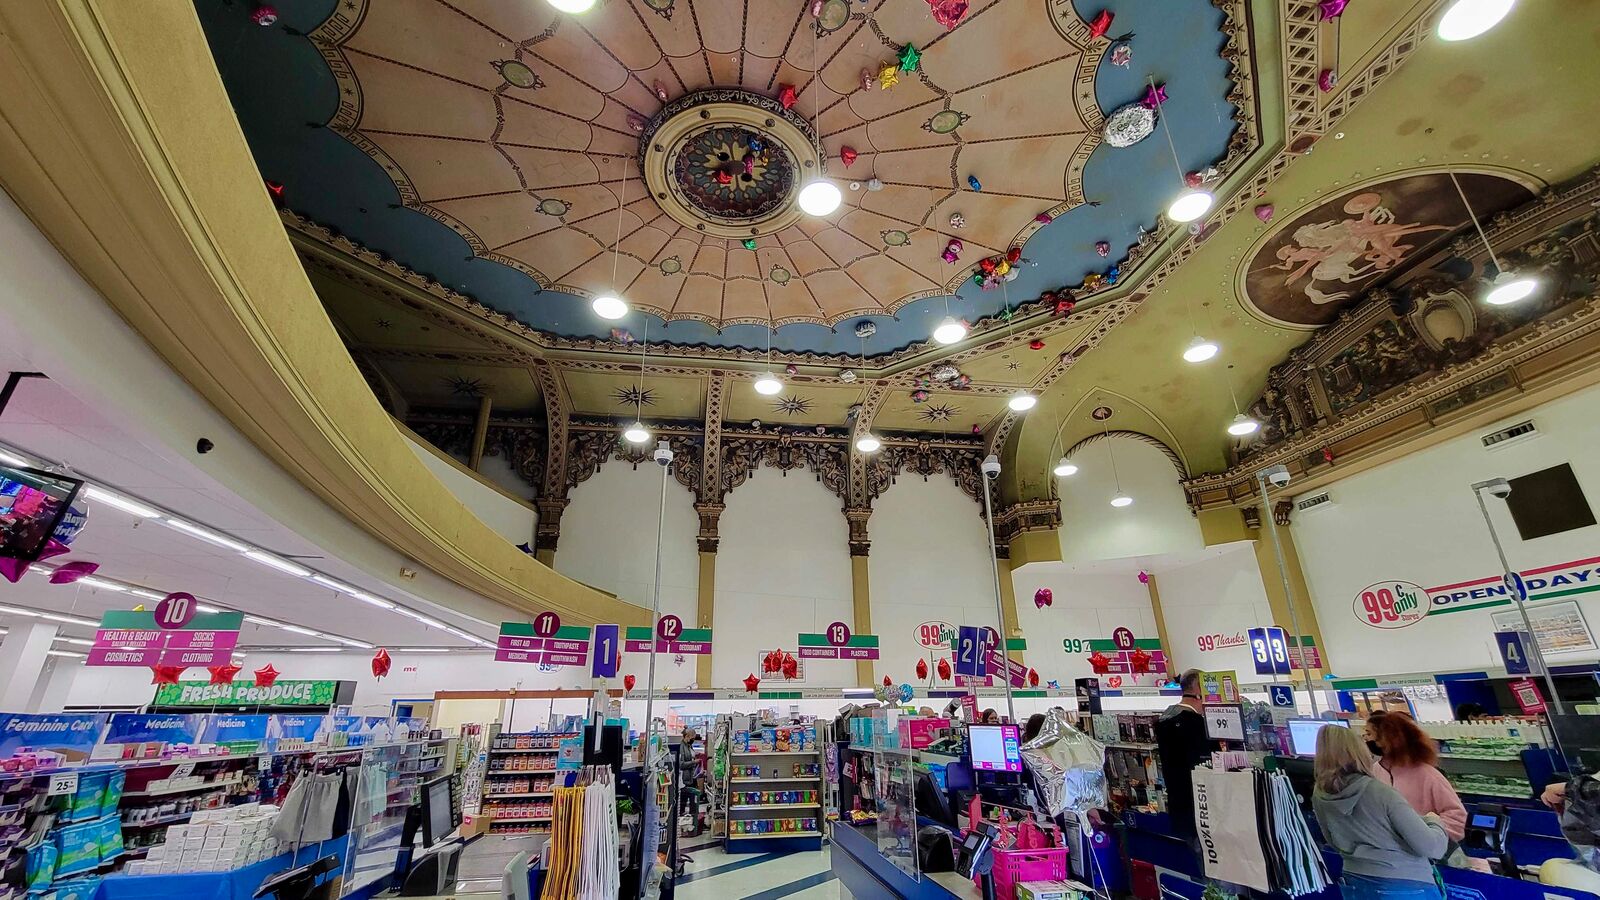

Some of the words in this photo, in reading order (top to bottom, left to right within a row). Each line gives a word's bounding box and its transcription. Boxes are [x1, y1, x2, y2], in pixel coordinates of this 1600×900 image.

[1432, 585, 1506, 606] OPEN
[1525, 566, 1600, 591] DAY
[163, 598, 189, 624] 10
[1362, 588, 1399, 624] 99
[1394, 592, 1418, 614] only
[541, 615, 553, 634] 11
[663, 619, 676, 637] 12
[103, 631, 128, 641] HEALTH
[134, 631, 161, 641] BEAUTY
[193, 632, 215, 641] SOCKS
[831, 626, 844, 643] 13
[920, 624, 940, 646] 99
[1117, 630, 1130, 647] 15
[1197, 634, 1214, 652] 99
[1213, 631, 1246, 647] Thanks
[602, 638, 610, 665] 1
[961, 638, 972, 663] 2
[979, 640, 985, 665] 2
[1063, 638, 1082, 653] 99
[1254, 638, 1268, 663] 3
[1272, 638, 1285, 663] 3
[1506, 642, 1521, 664] 4
[104, 652, 144, 662] COSMETICS
[181, 652, 214, 662] CLOTHING
[181, 685, 232, 702] FRESH
[235, 683, 312, 702] PRODUCE
[5, 718, 68, 732] Feminine
[71, 719, 93, 731] Care
[145, 717, 185, 729] Medicine
[216, 719, 246, 728] Medicine
